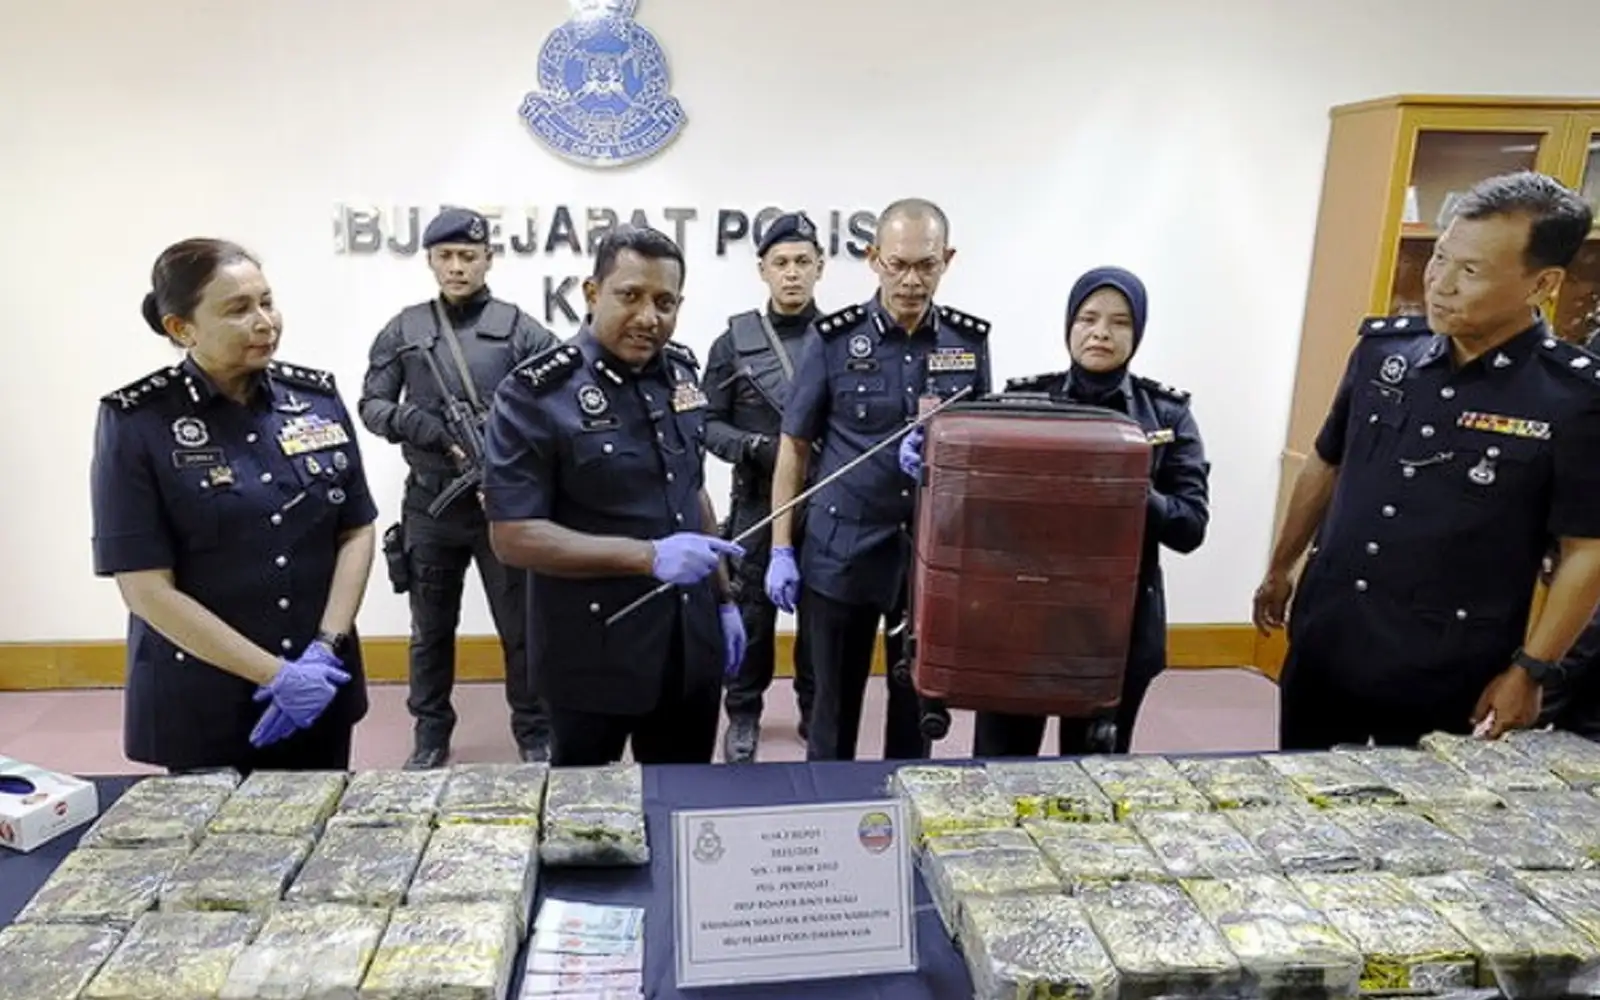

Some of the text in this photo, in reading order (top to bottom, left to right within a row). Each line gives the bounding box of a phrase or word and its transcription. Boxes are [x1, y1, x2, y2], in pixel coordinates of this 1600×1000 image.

[334, 202, 878, 258] IBU EJABT POIS
